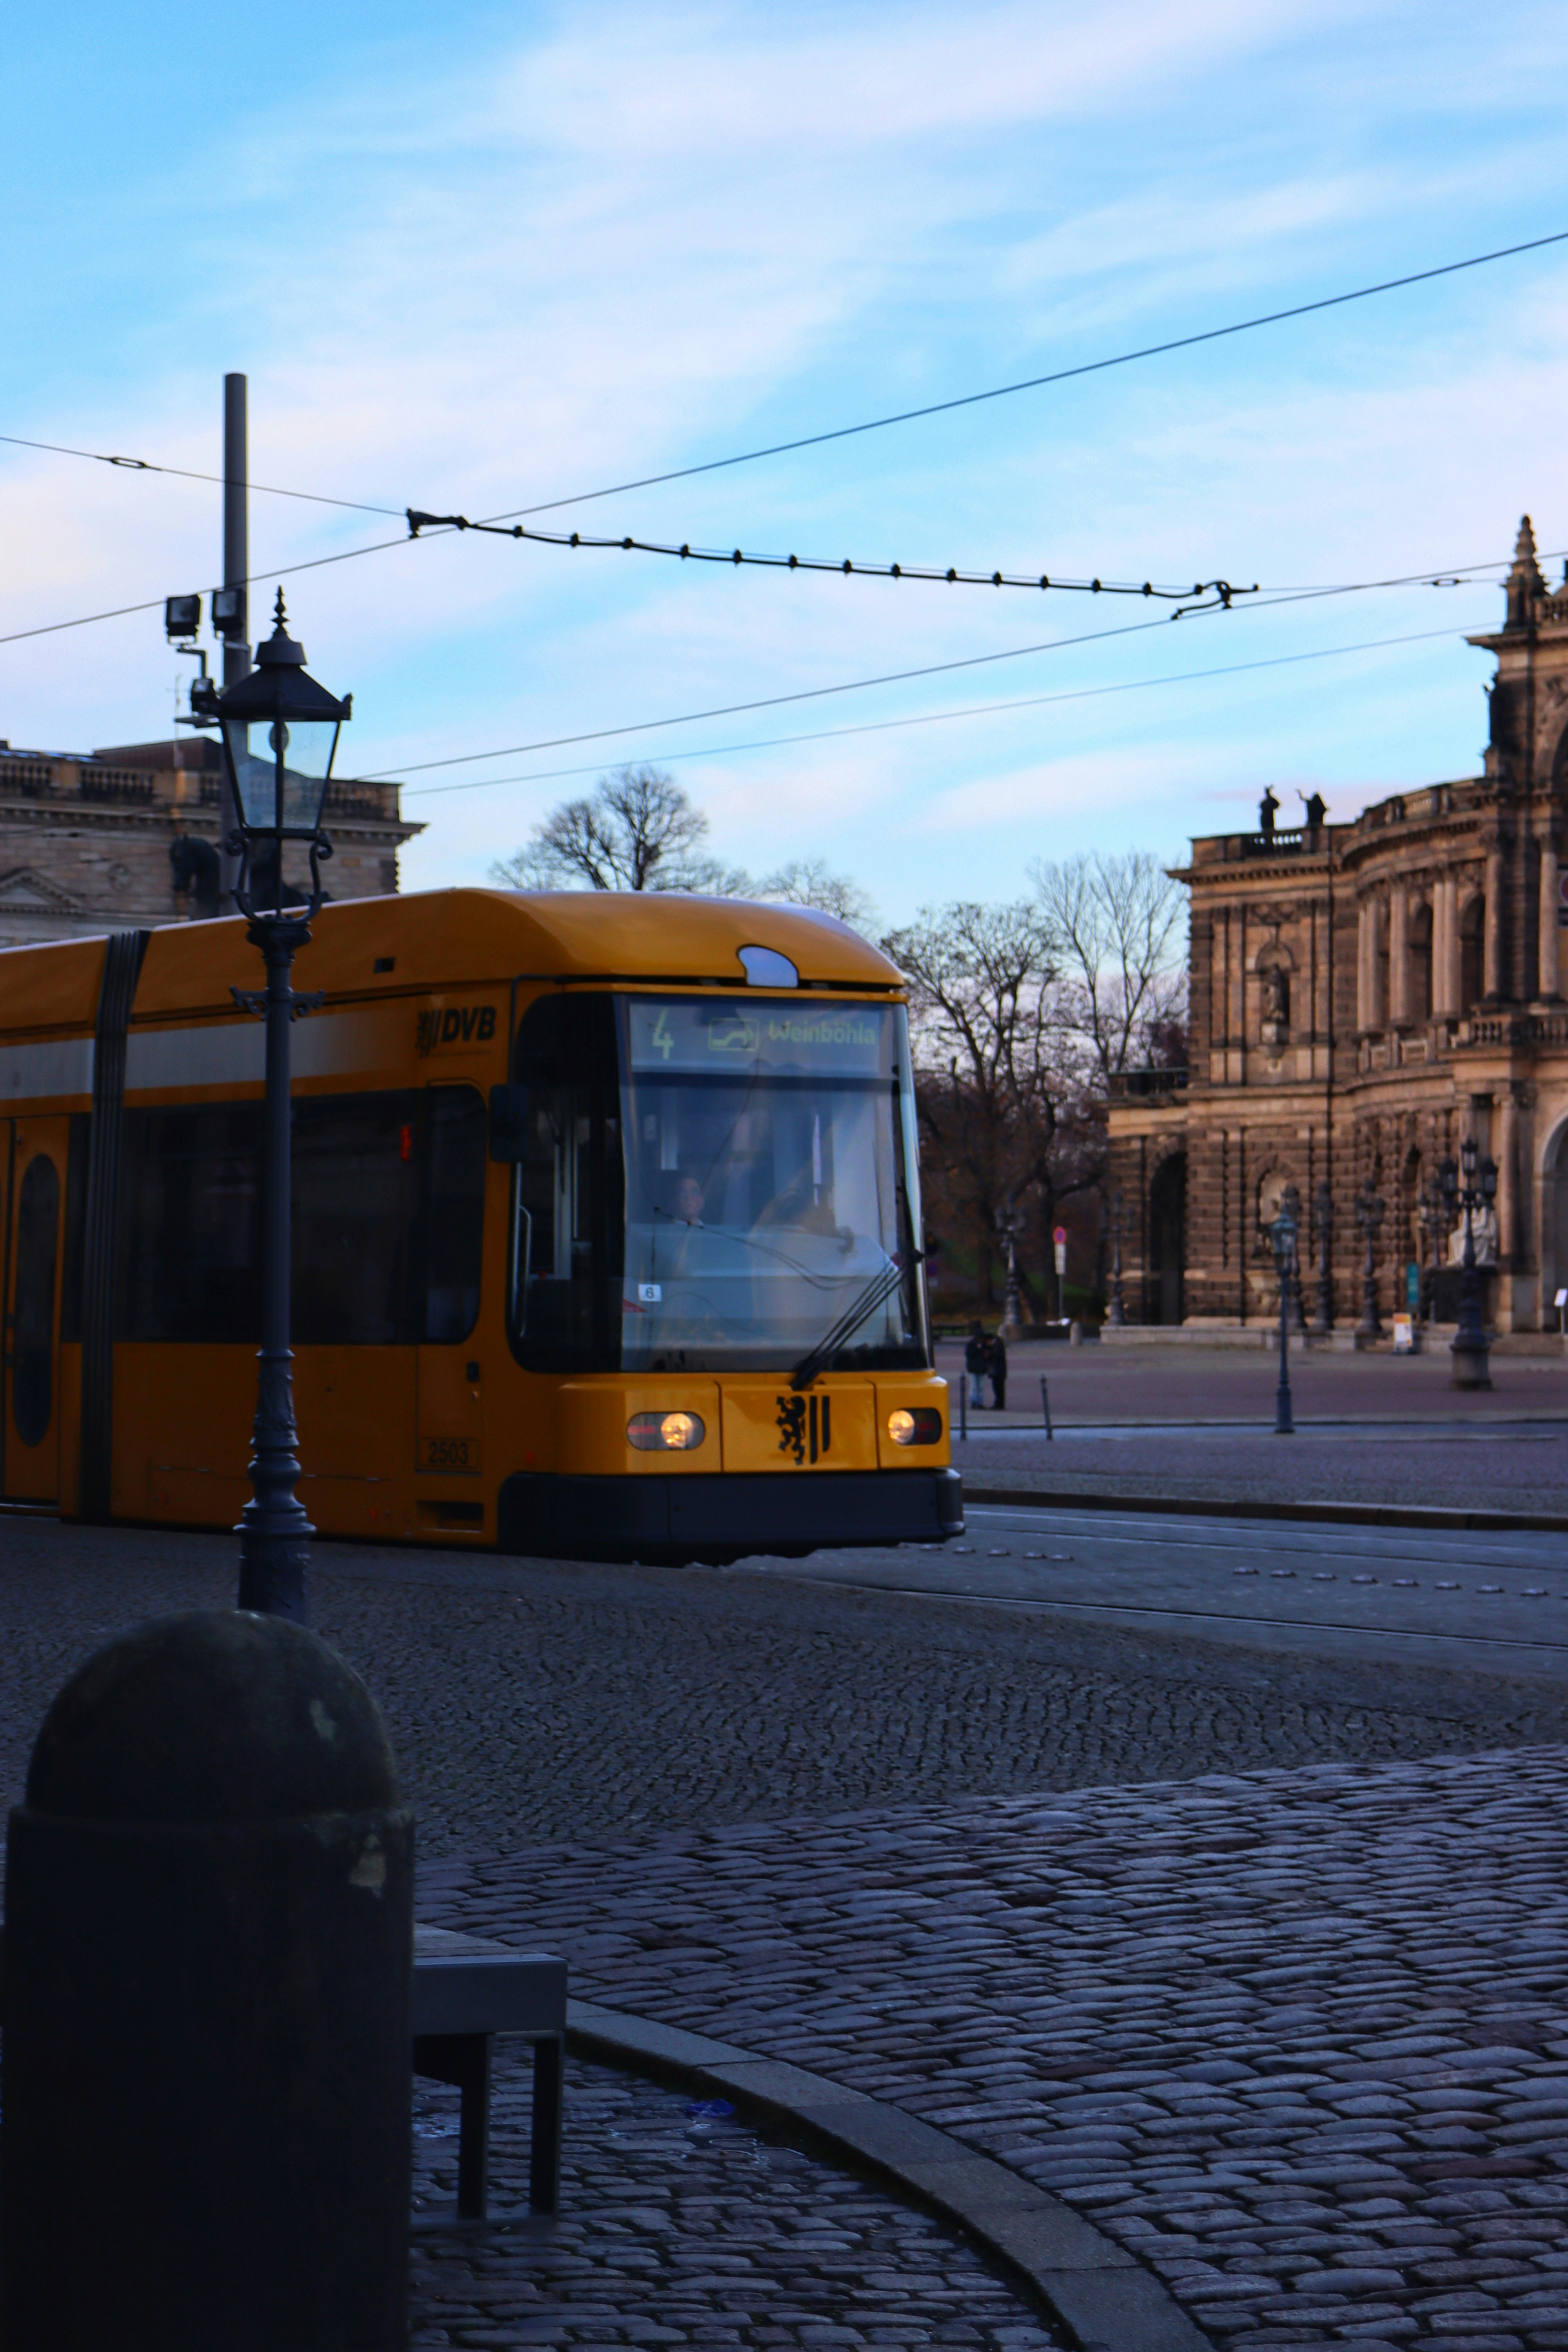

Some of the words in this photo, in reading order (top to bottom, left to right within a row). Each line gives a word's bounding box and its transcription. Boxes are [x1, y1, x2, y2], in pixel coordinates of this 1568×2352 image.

[441, 1005, 496, 1042] DVB
[652, 1007, 674, 1059] 4
[768, 1019, 875, 1045] Weinböhla
[646, 1287, 653, 1299] 6
[428, 1441, 468, 1465] 2503
